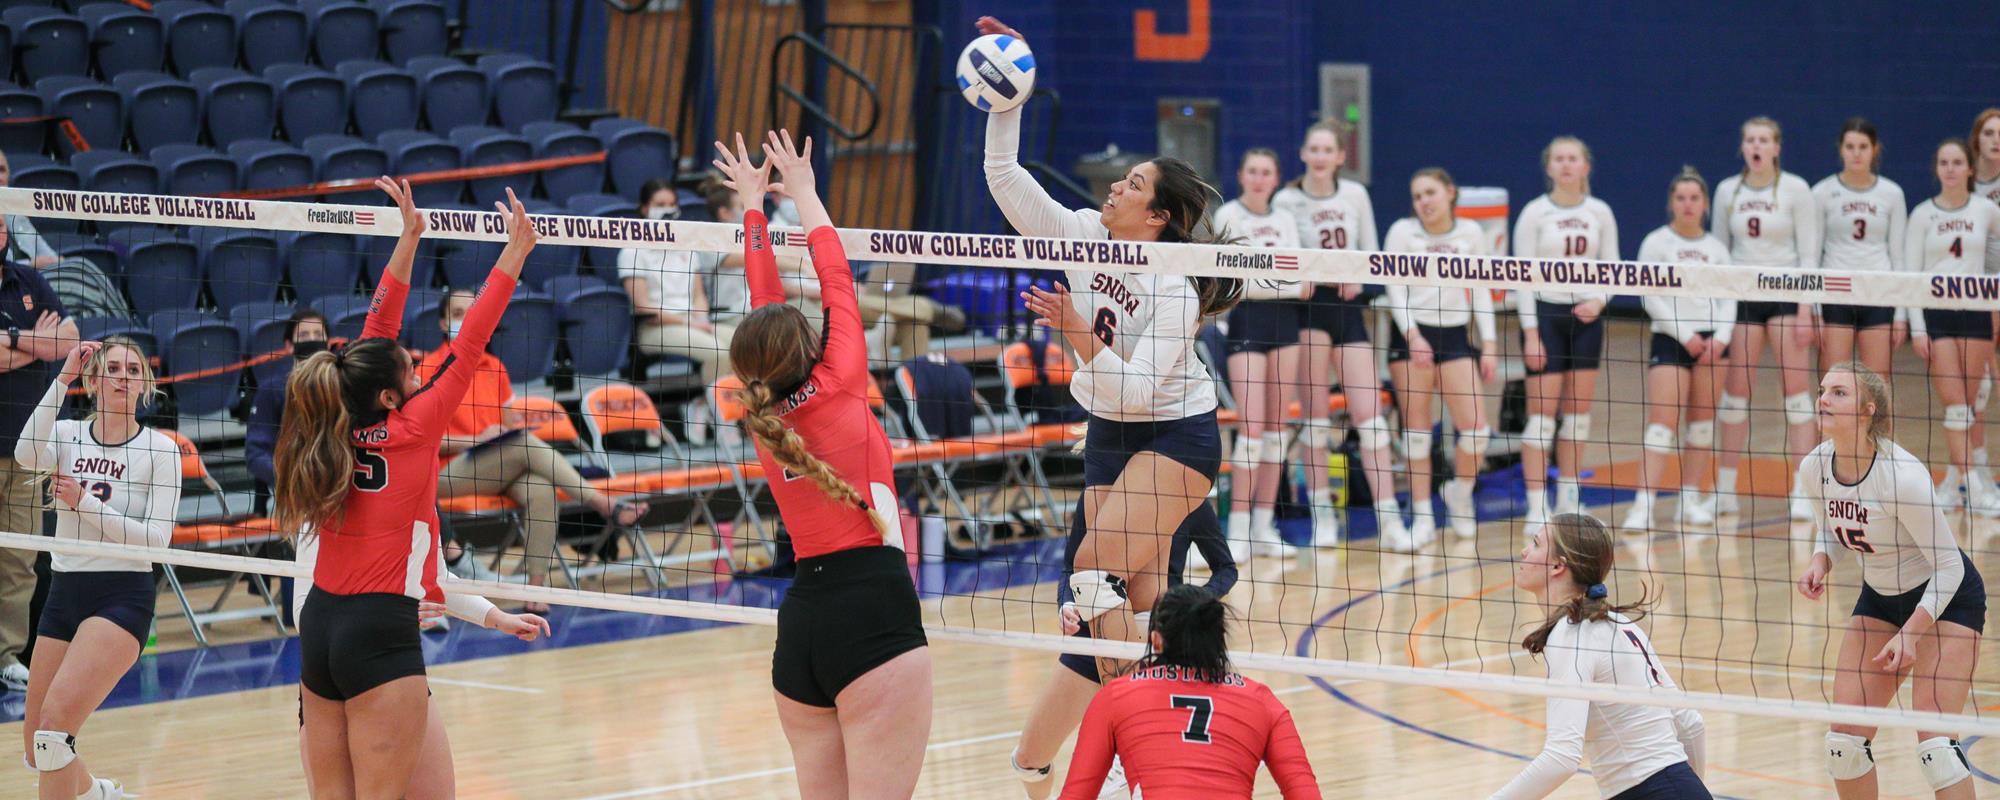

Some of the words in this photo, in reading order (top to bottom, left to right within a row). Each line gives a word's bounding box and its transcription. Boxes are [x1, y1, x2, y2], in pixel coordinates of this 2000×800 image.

[33, 191, 77, 212] SNOW
[81, 194, 151, 215] COLLEGE
[155, 197, 256, 221] VOLLEYBALL
[308, 208, 354, 225] FreeTaxUSA
[429, 210, 476, 233] SNOW
[483, 213, 559, 237] COGE
[563, 218, 676, 243] VOLLEYBALL
[1320, 227, 1346, 249] 20
[1748, 217, 1760, 238] 9
[1853, 219, 1866, 240] 3
[870, 232, 924, 255] SNOW
[930, 235, 1016, 259] COLLEGE
[1023, 239, 1149, 265] VOLLEYBALL
[1564, 235, 1587, 257] 10
[1949, 237, 1963, 258] 4
[1216, 252, 1273, 270] FreeTaxUSA
[1369, 254, 1429, 278] SNOW
[1438, 256, 1532, 282] COLLEGE
[1540, 261, 1682, 288] VOLLEYBALL
[1758, 273, 1823, 291] FreeTaxUSA
[1931, 275, 2000, 300] SNOW
[1090, 272, 1140, 318] SNOW
[1094, 307, 1117, 347] 6
[72, 457, 126, 480] SNOW
[352, 445, 388, 493] 5
[1828, 500, 1869, 525] SNOW
[1835, 526, 1875, 554] 15
[1169, 694, 1214, 744] 7
